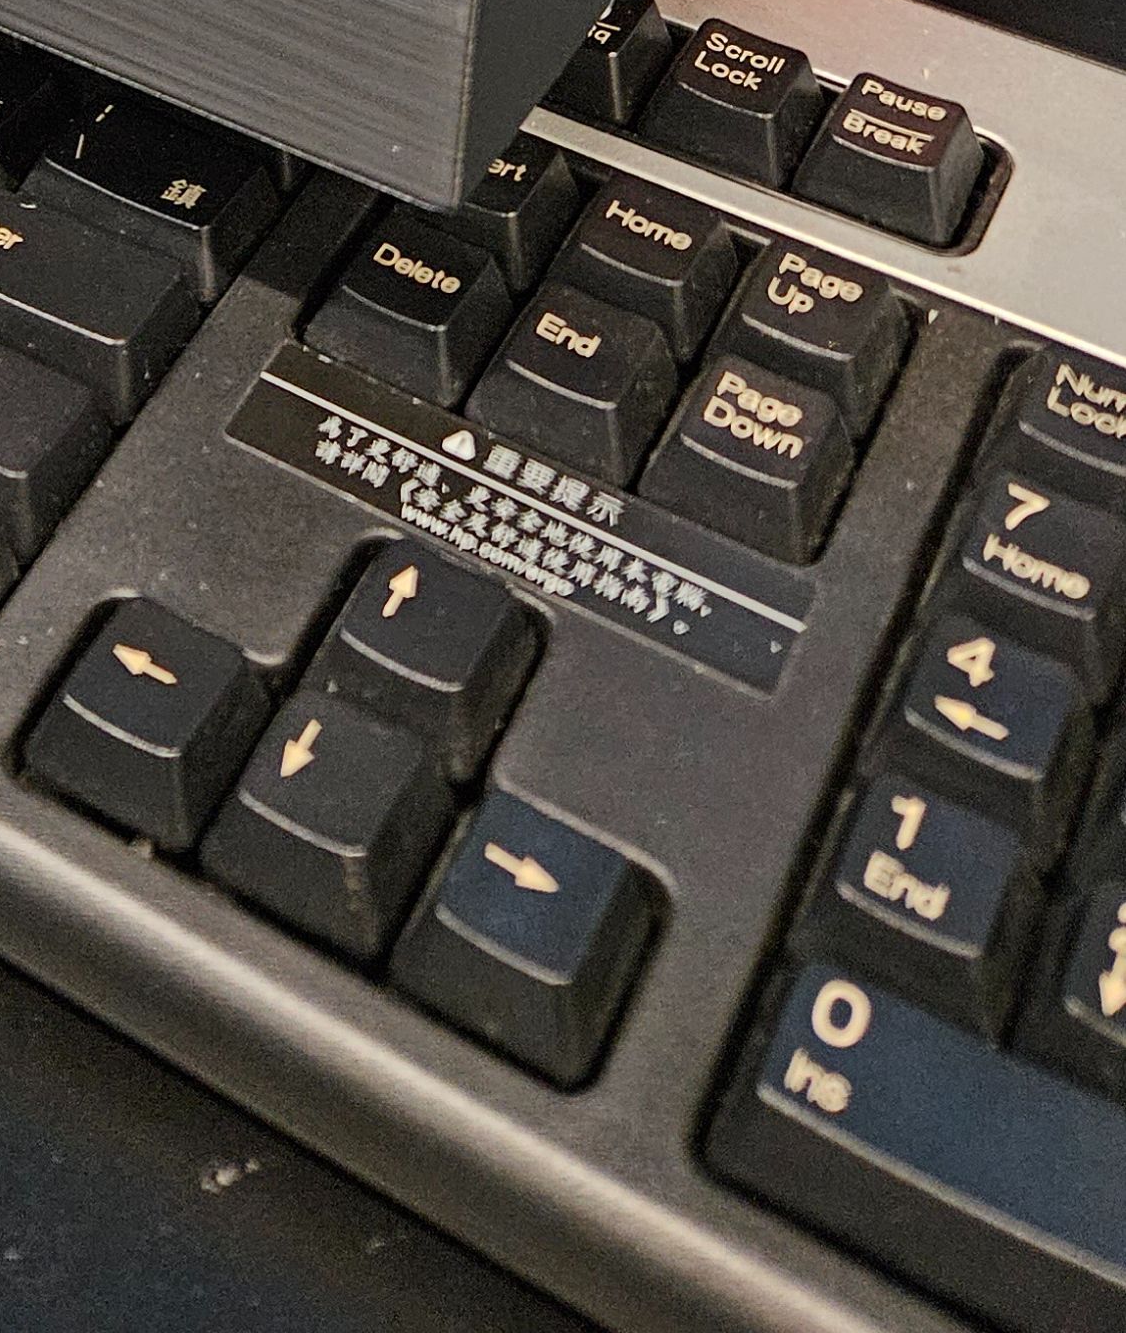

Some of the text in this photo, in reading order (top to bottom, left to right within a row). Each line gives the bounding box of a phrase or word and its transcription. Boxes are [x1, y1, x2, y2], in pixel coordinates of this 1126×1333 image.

[694, 49, 764, 95] Lock
[704, 29, 788, 77] Scroll
[859, 77, 950, 123] Pause
[840, 111, 928, 159] Break
[605, 199, 693, 251] Home
[373, 242, 461, 294] Delete
[775, 249, 868, 305] Page
[767, 275, 818, 315] Up
[536, 312, 602, 358] End
[714, 371, 803, 430] Page
[701, 393, 804, 461] Down
[1004, 482, 1050, 531] 7
[983, 533, 1090, 602] Home
[947, 637, 996, 687] 4
[891, 795, 927, 850] 1
[860, 851, 950, 923] End
[811, 979, 871, 1048] 0
